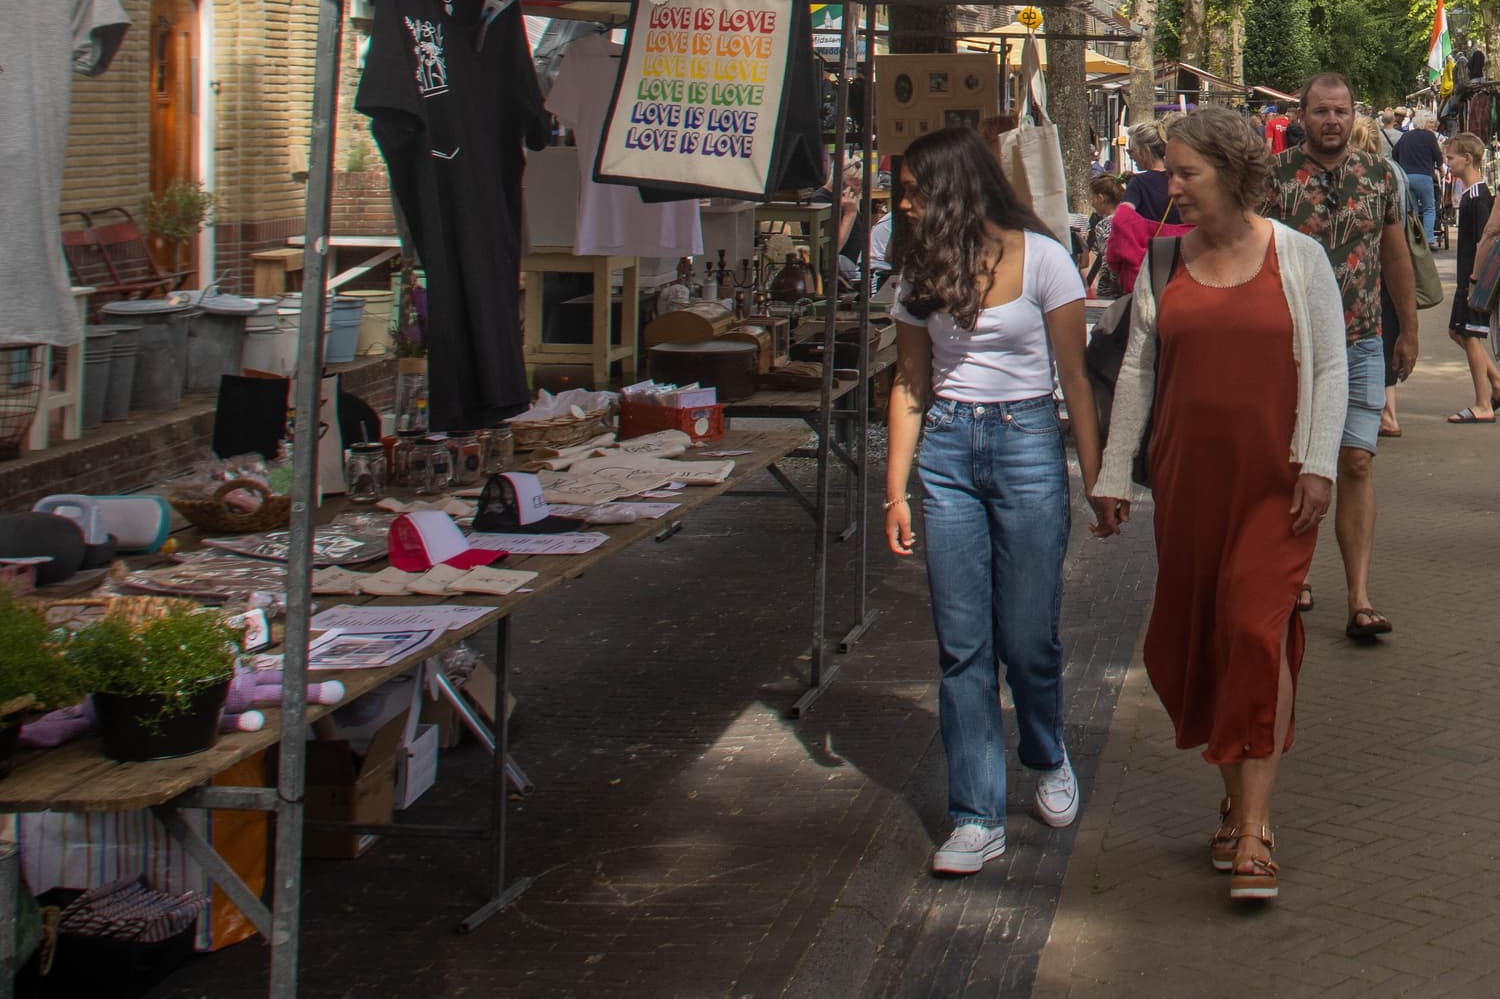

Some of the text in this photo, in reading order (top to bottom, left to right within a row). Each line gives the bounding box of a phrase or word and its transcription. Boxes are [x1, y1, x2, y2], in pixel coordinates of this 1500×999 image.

[650, 7, 776, 33] LOVE IS LOVE
[646, 31, 773, 59] LOVE IS LOVE
[642, 55, 769, 83] LOVE IS LOVE
[638, 78, 765, 106] LOVE IS LOVE
[631, 102, 758, 134] LOVE IS LOVE
[625, 127, 753, 158] LOVE IS LOVE
